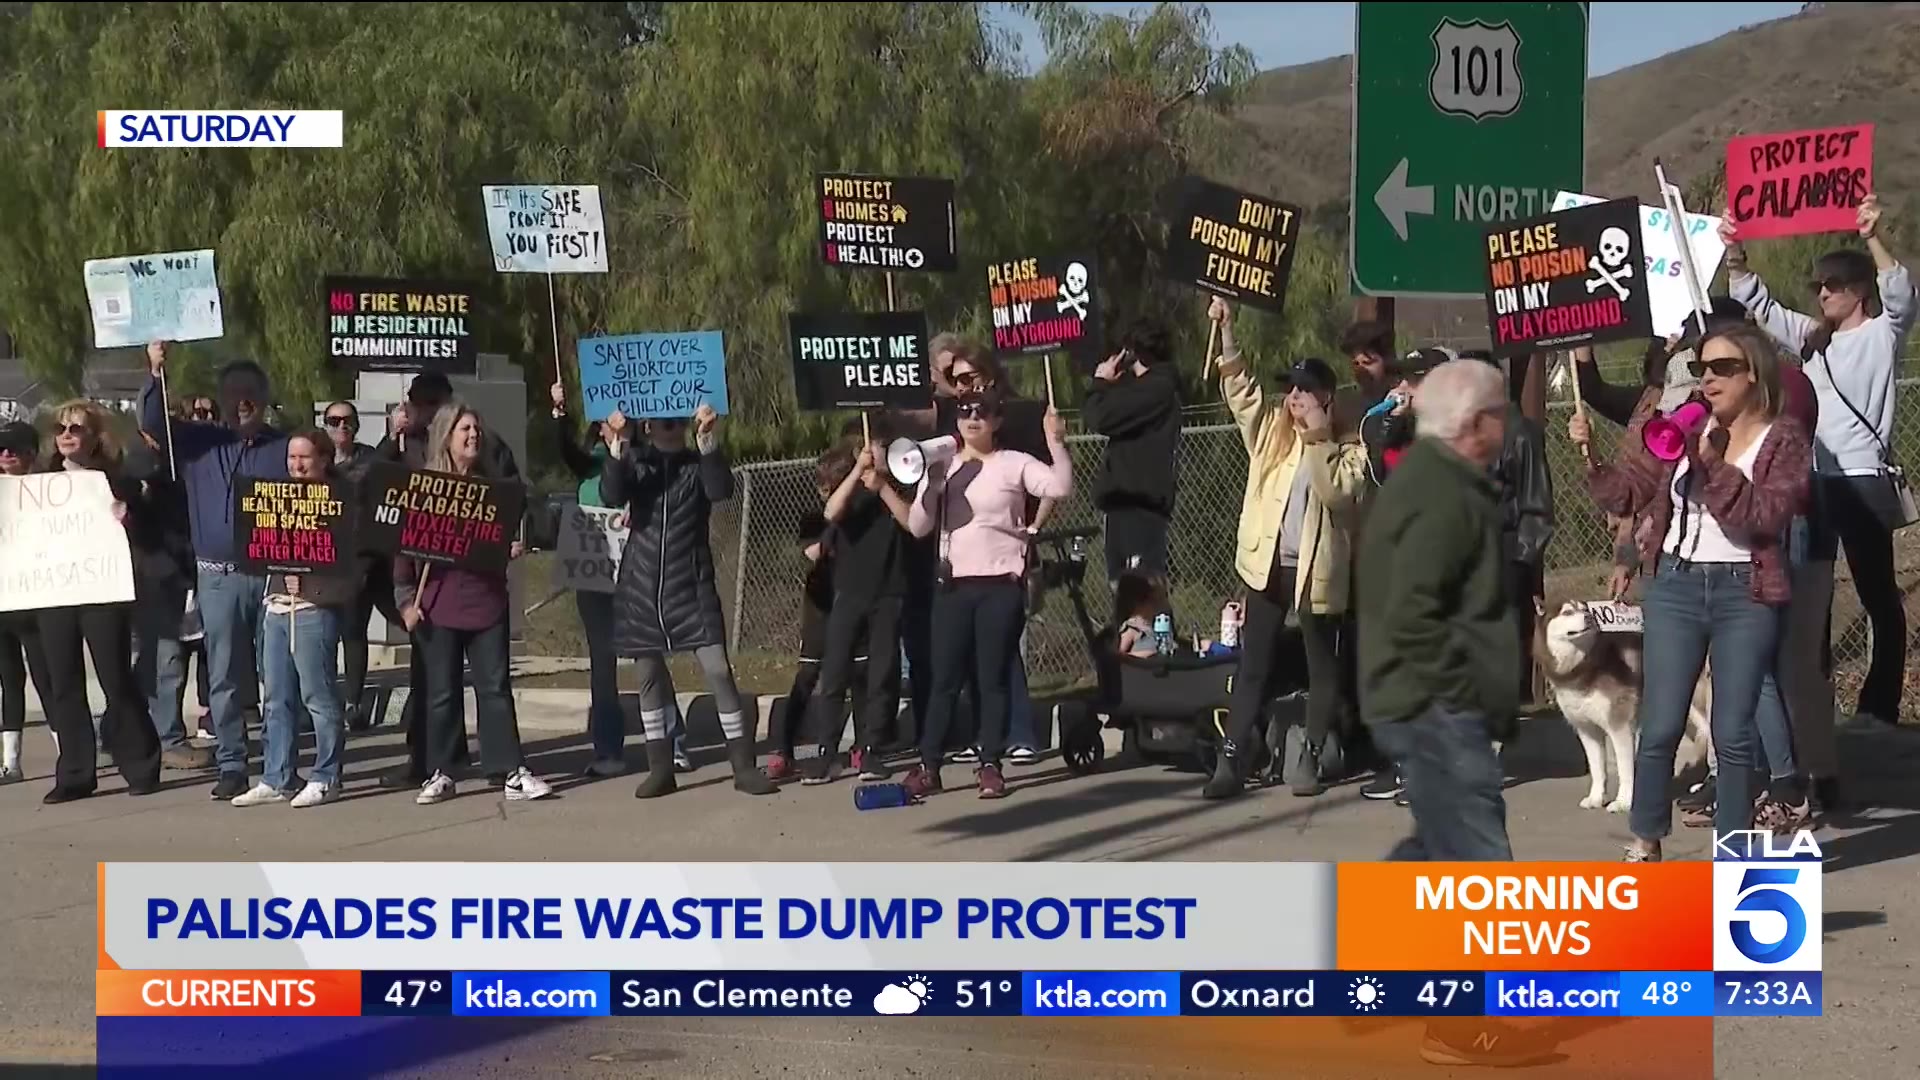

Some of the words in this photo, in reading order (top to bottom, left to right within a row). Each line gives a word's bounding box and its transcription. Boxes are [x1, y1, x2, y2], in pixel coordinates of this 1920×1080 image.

[1451, 46, 1503, 97] 101
[1750, 131, 1859, 173] PROTECT
[824, 178, 892, 200] PROTECT
[508, 210, 546, 229] PROVE
[835, 201, 889, 222] HOMES
[1238, 199, 1293, 236] DON'T
[1647, 209, 1709, 237] STP
[506, 232, 537, 255] YOU
[826, 222, 895, 244] PROTECT
[1190, 216, 1252, 257] POISON
[1255, 236, 1287, 266] MY
[1487, 222, 1558, 260] PLEASE
[838, 244, 904, 267] HEALTH!
[1491, 259, 1515, 287] NO
[1519, 246, 1587, 282] POISON
[988, 258, 1037, 286] PLEASE
[1206, 253, 1277, 298] FUTURE.
[330, 292, 355, 312] NO
[359, 292, 401, 312] FIRE
[405, 293, 470, 313] WASTE
[991, 285, 1008, 309] NO
[1010, 275, 1058, 305] POISON
[1494, 287, 1519, 315] ON
[1522, 281, 1550, 310] MY
[330, 315, 349, 333] IN
[353, 315, 470, 336] RESIDENTIAL
[993, 305, 1011, 329] ON
[1013, 301, 1033, 325] MY
[1497, 297, 1629, 345] PLAYGROUND.
[331, 337, 458, 358] COMMUNITIES!
[799, 336, 881, 360] PROTECT
[888, 334, 919, 358] ME
[995, 317, 1086, 350] PLAYGROUND.
[593, 340, 654, 367] SAFETY
[659, 338, 703, 356] OVER
[611, 360, 708, 380] SHORTCUTS
[844, 363, 921, 388] PLEASE
[585, 379, 662, 403] PROTECT
[670, 378, 713, 396] OUR
[617, 394, 703, 416] CHILDREN!
[18, 472, 73, 511] NO
[254, 481, 303, 499] PROTECT
[306, 484, 330, 500] OUR
[408, 473, 490, 503] PROTECT
[242, 497, 287, 514] HEALTH,
[291, 499, 343, 516] PROTECT
[384, 487, 498, 523] CALABASAS
[256, 513, 277, 528] OUR
[374, 504, 401, 526] NO
[405, 509, 457, 535] TOXIC
[461, 519, 504, 543] FIRE
[252, 527, 278, 545] FIND
[281, 529, 290, 545] A
[292, 530, 333, 547] SAFER
[400, 527, 471, 557] WASTE!
[248, 543, 290, 561] BETTER
[293, 544, 336, 563] PLACE!
